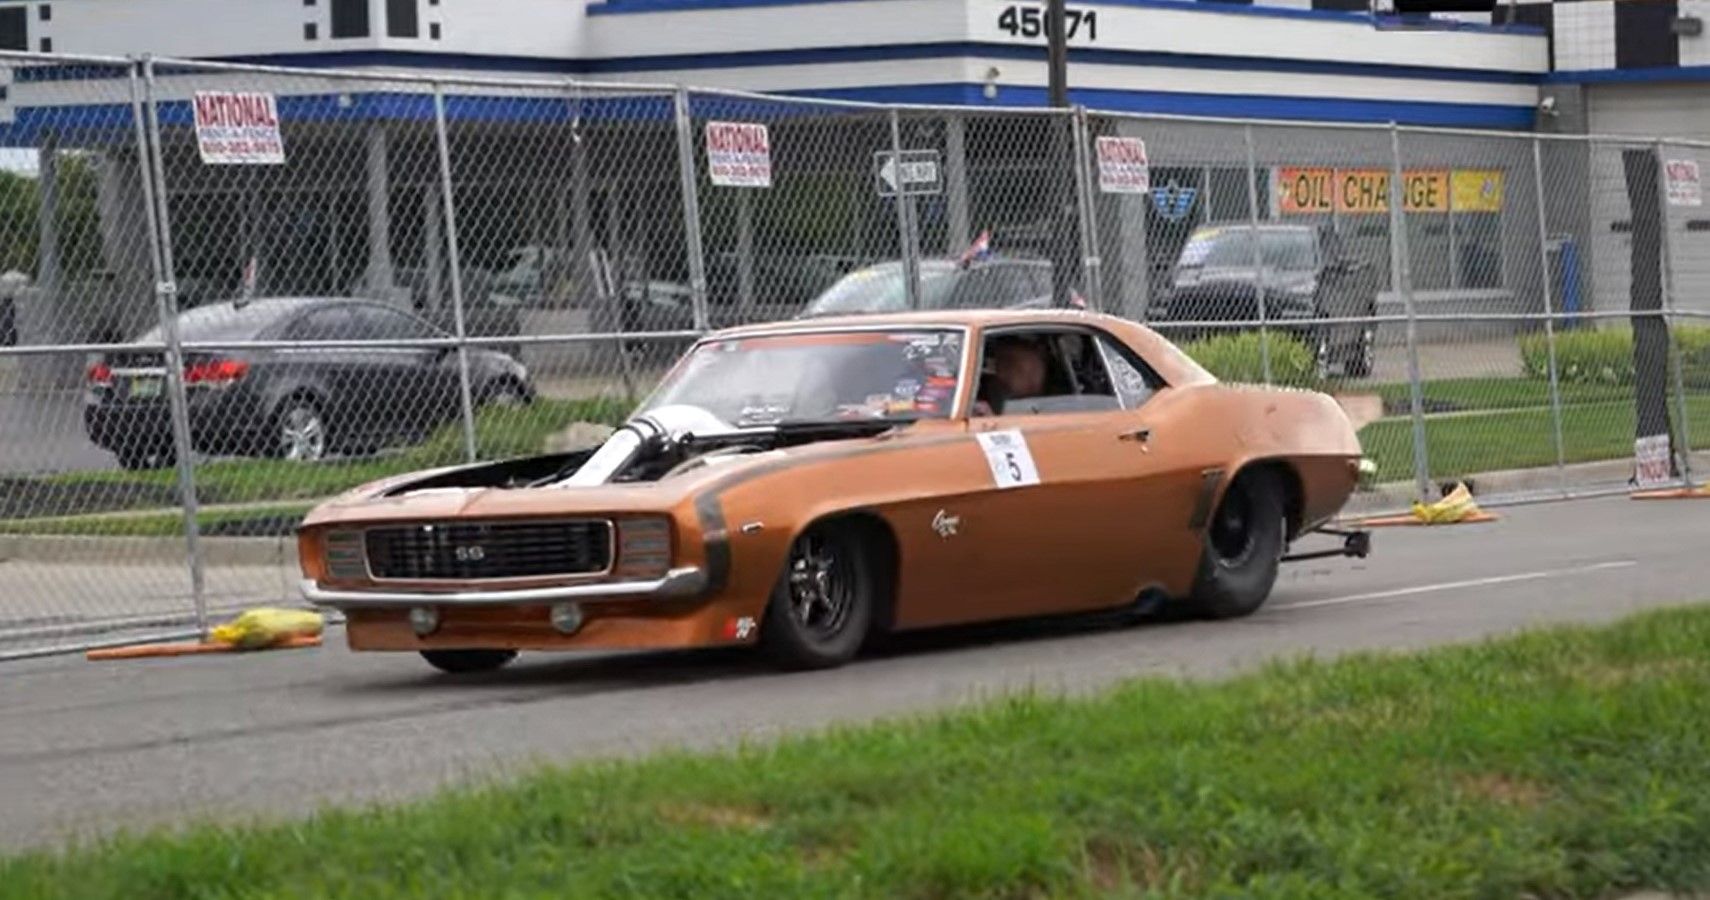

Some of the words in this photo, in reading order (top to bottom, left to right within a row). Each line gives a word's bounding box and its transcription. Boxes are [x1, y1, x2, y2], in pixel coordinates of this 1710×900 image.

[998, 6, 1096, 39] 4571
[195, 95, 275, 127] NATIONAL
[709, 126, 766, 153] NATIONAL
[1295, 175, 1329, 207] OIL
[1005, 452, 1021, 481] 5
